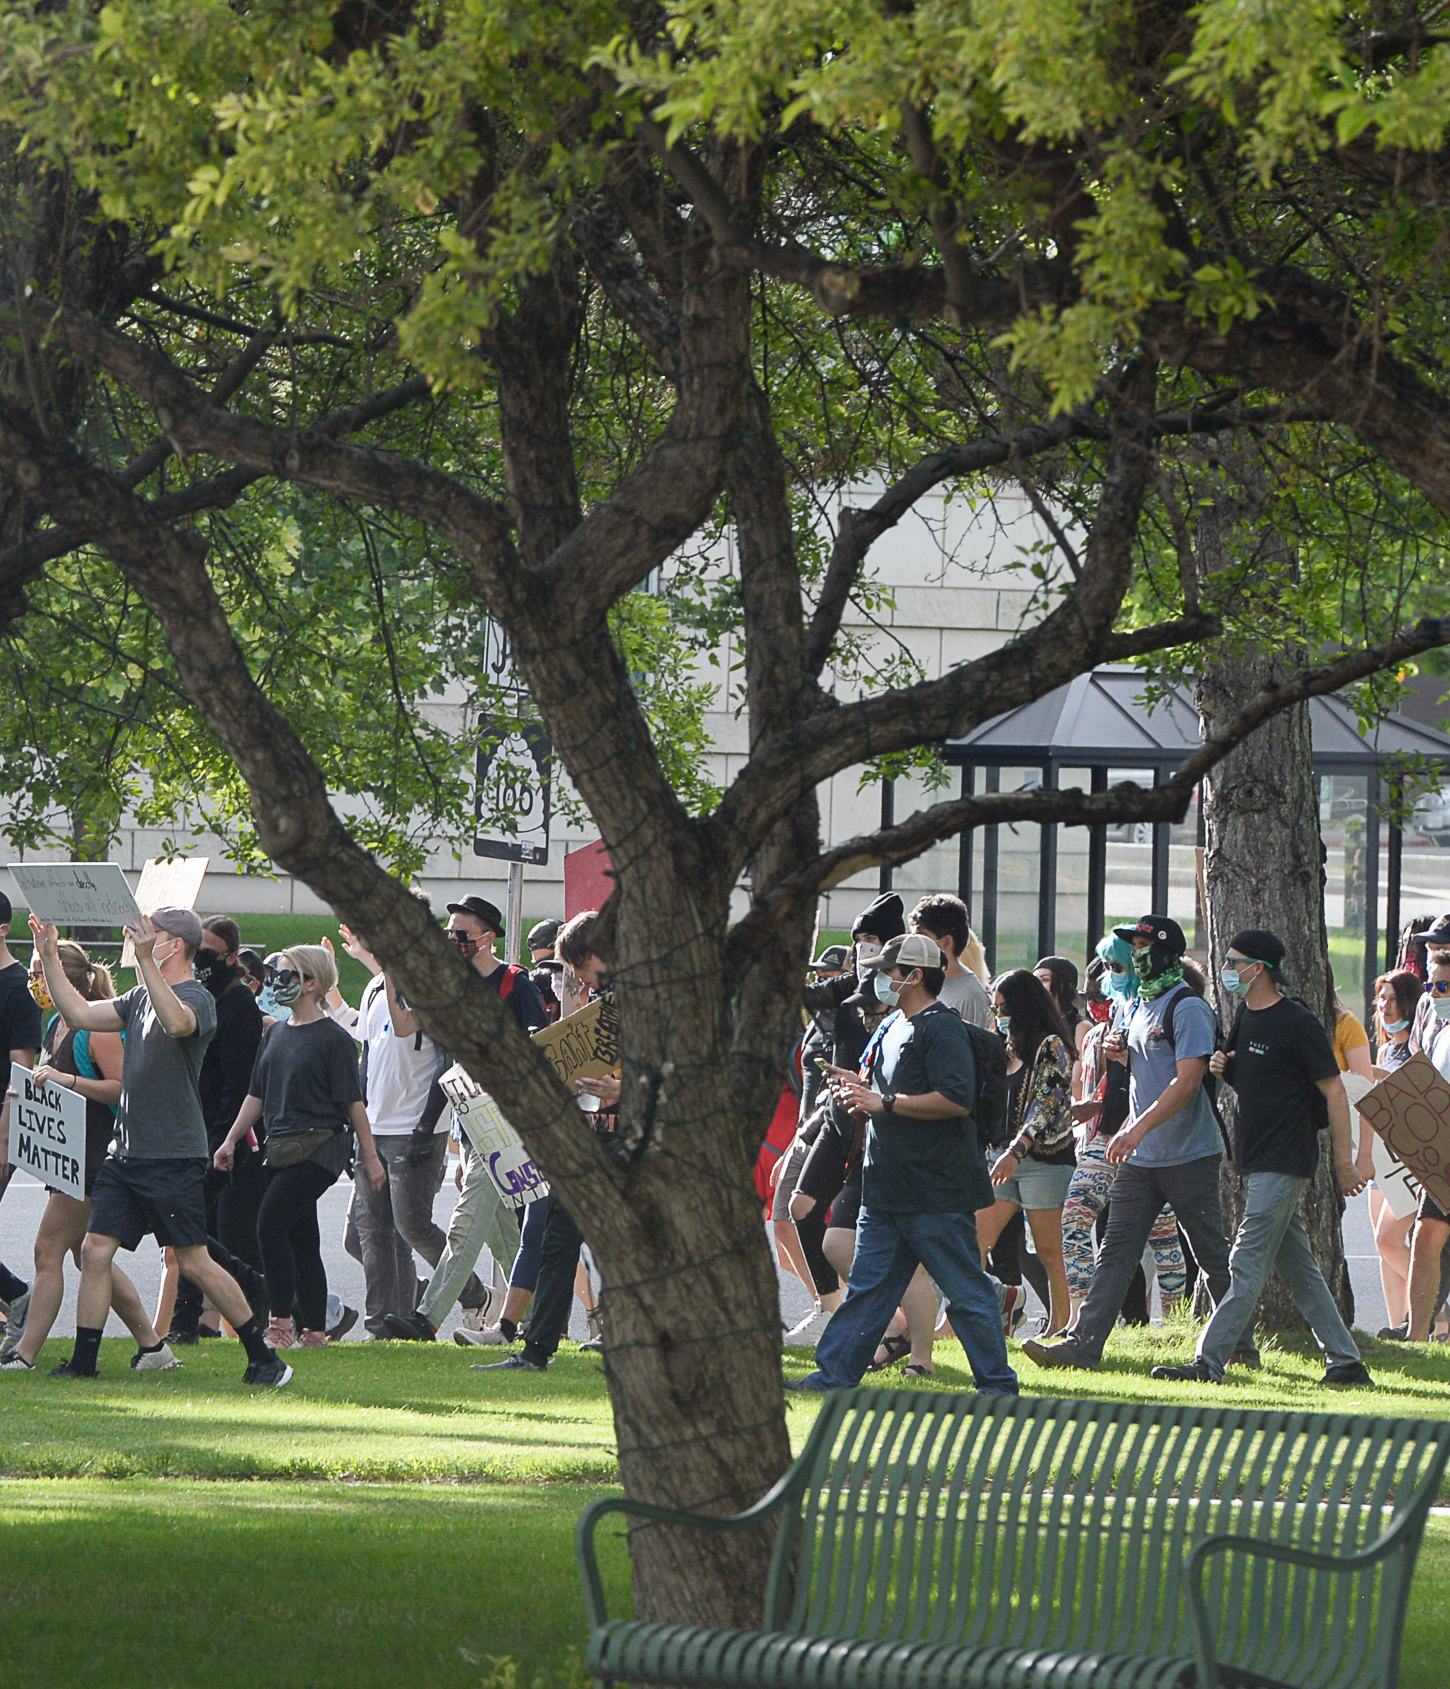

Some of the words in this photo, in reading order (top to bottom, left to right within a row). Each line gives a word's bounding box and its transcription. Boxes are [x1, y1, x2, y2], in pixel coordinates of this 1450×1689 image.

[24, 1078, 62, 1113] BLACK
[1357, 1061, 1436, 1132] BAD
[18, 1104, 66, 1144] LIVES
[1388, 1087, 1450, 1157] COP
[18, 1132, 79, 1186] MATTER
[1409, 1146, 1440, 1179] NO
